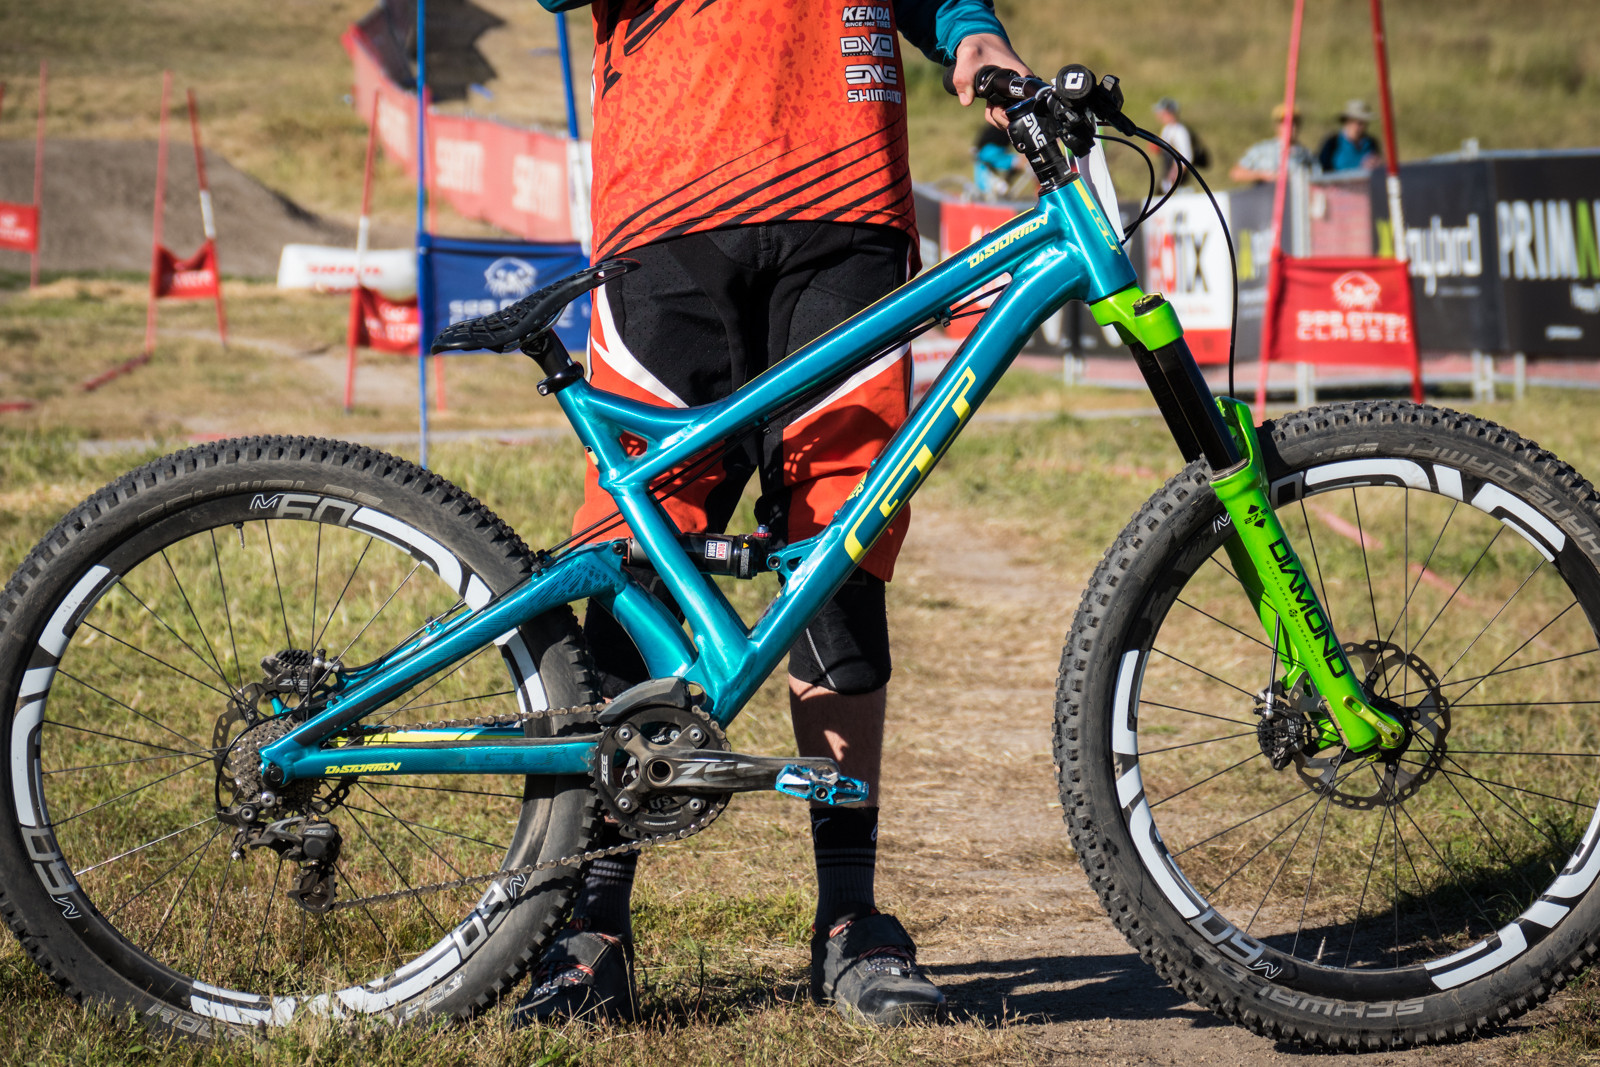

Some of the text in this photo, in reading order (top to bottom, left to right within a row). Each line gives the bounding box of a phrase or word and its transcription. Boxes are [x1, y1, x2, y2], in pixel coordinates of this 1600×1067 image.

[842, 6, 890, 21] KENDA
[876, 21, 891, 29] TIRES
[840, 34, 893, 53] DVO
[847, 89, 902, 104] SHIMANO
[1497, 199, 1600, 280] PRIMA
[1390, 443, 1518, 483] DAMPF
[1243, 508, 1269, 525] 27.5
[1265, 560, 1322, 668] DEVELOPED SUSPENSION
[1268, 537, 1349, 679] DIAMOND
[324, 761, 402, 775] DISTORTION
[601, 753, 609, 786] ZEE
[304, 828, 329, 836] ZEE
